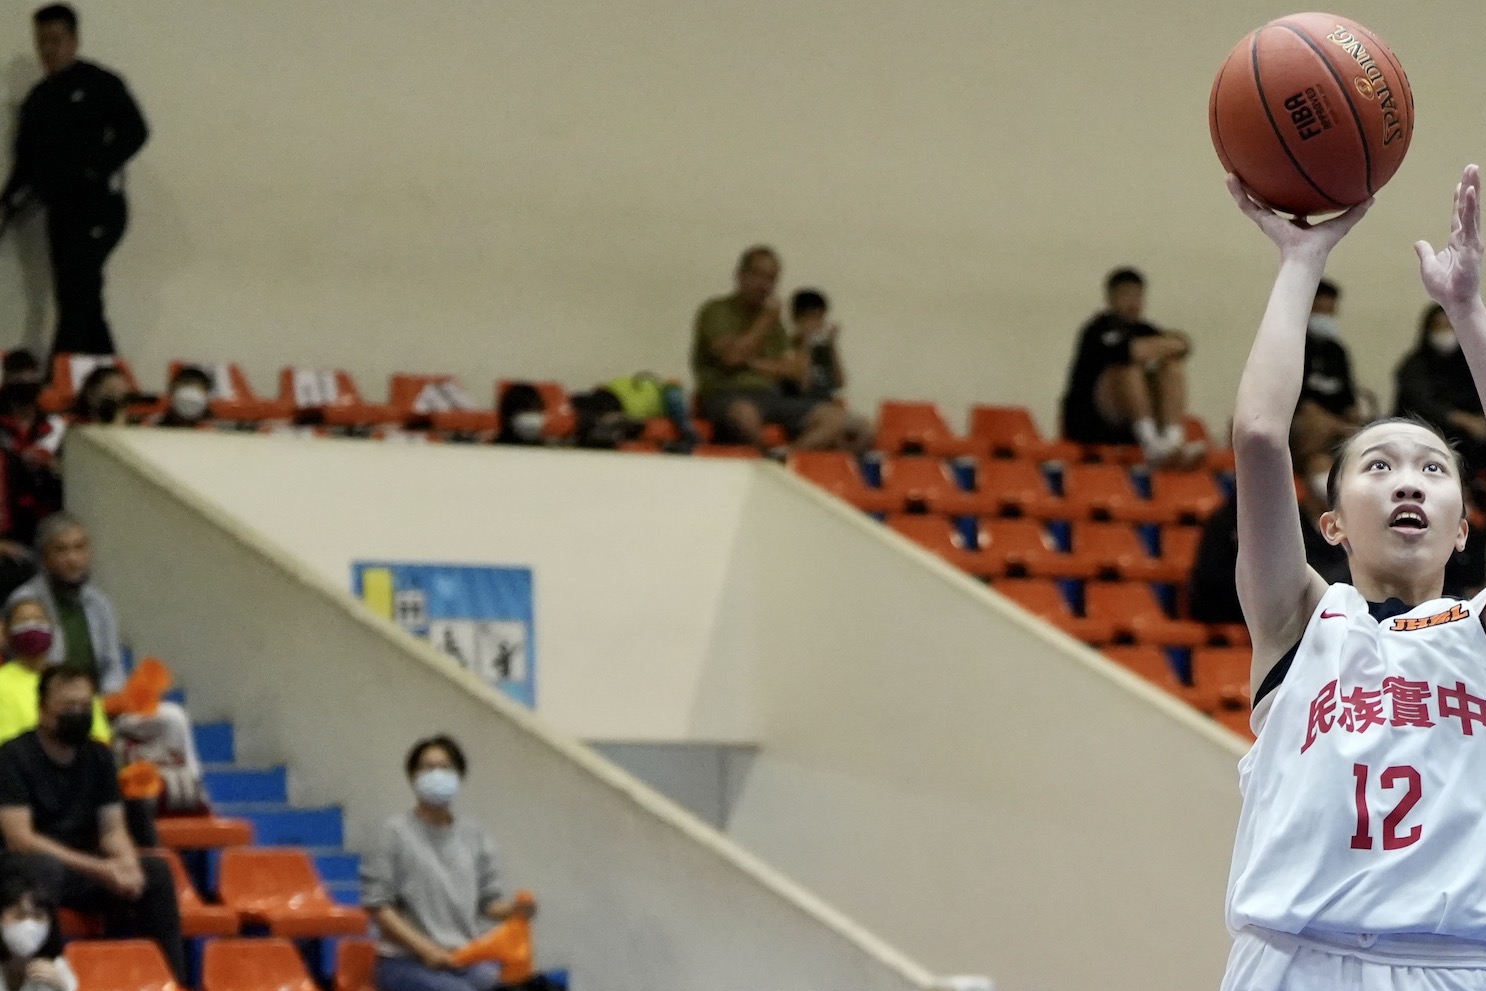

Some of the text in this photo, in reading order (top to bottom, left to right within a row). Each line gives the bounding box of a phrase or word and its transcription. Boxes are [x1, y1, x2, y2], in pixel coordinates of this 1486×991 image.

[1284, 91, 1322, 141] FIBA
[1327, 24, 1402, 146] SPALDING
[1350, 763, 1423, 851] 12
